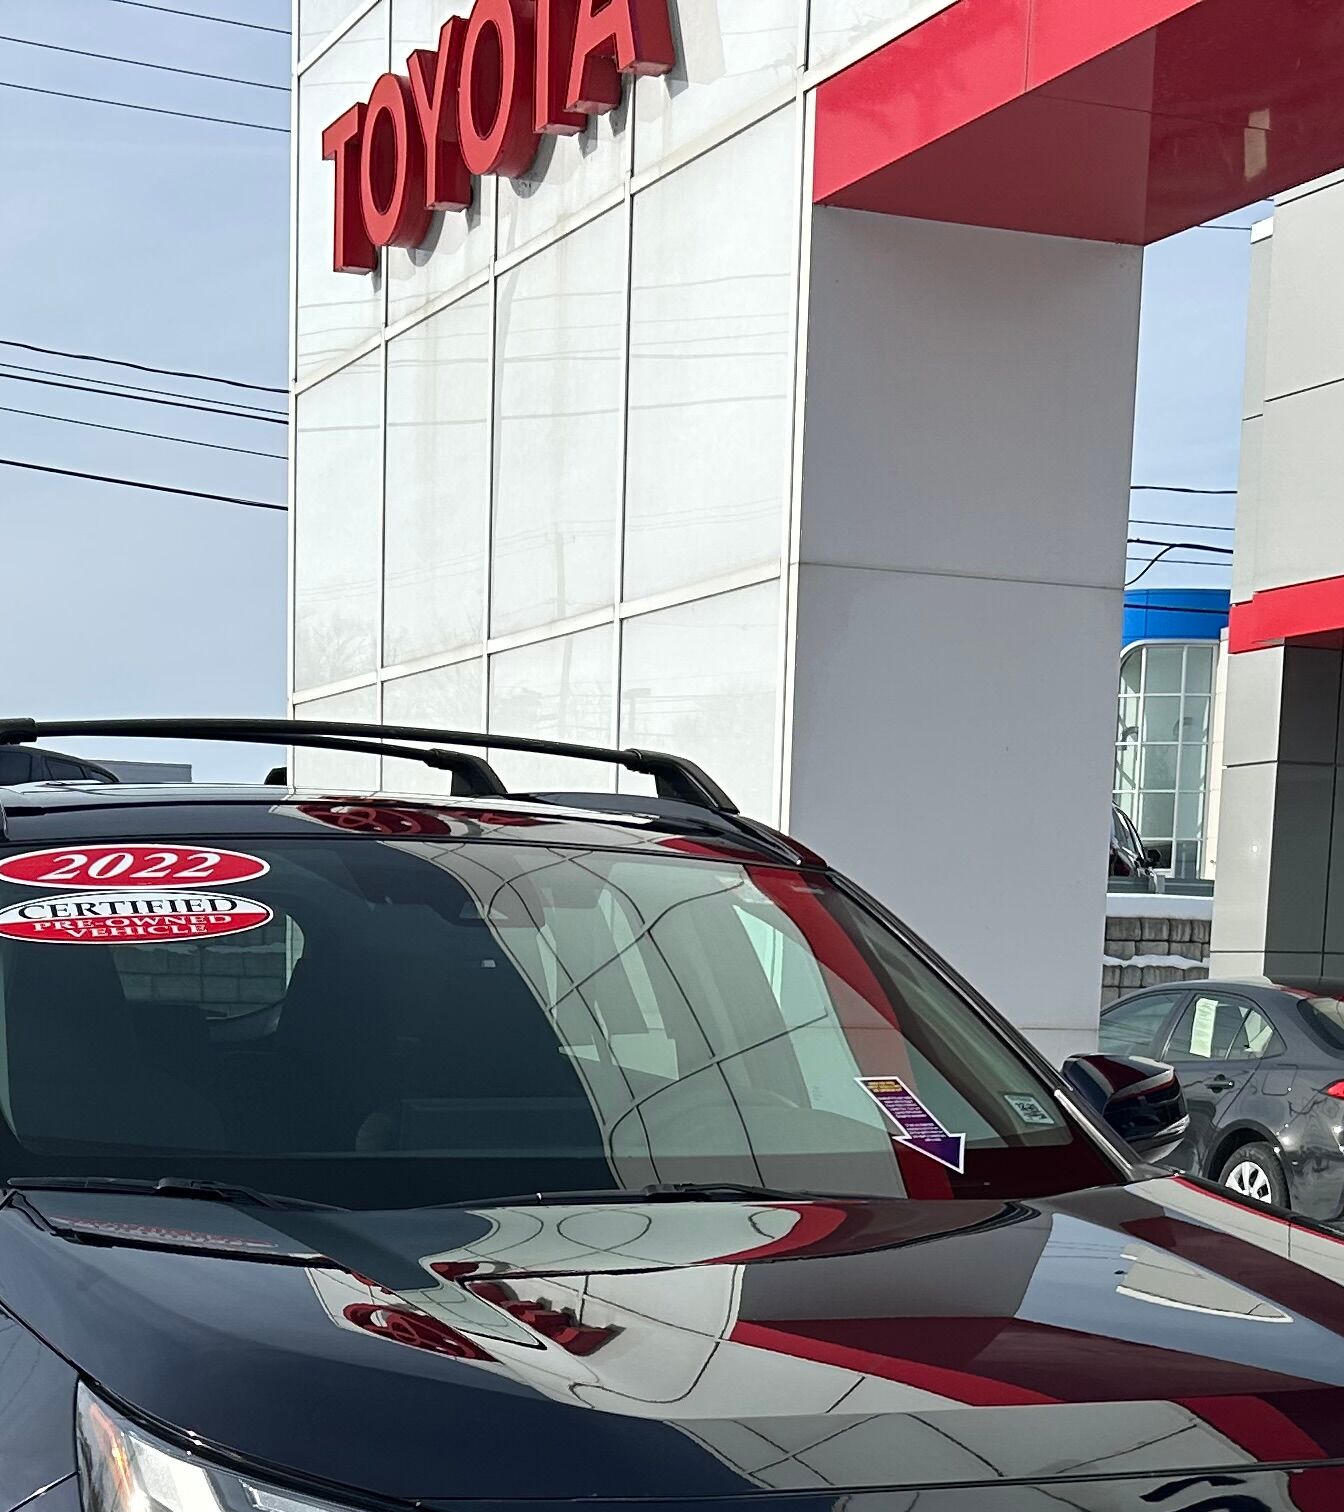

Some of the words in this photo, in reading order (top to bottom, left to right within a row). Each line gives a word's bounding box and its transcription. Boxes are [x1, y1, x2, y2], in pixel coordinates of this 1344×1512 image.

[37, 852, 221, 880] 2022
[18, 899, 238, 919] CERTIFIED
[33, 914, 232, 932] PRE-OWNED
[66, 924, 207, 938] VEHICLE
